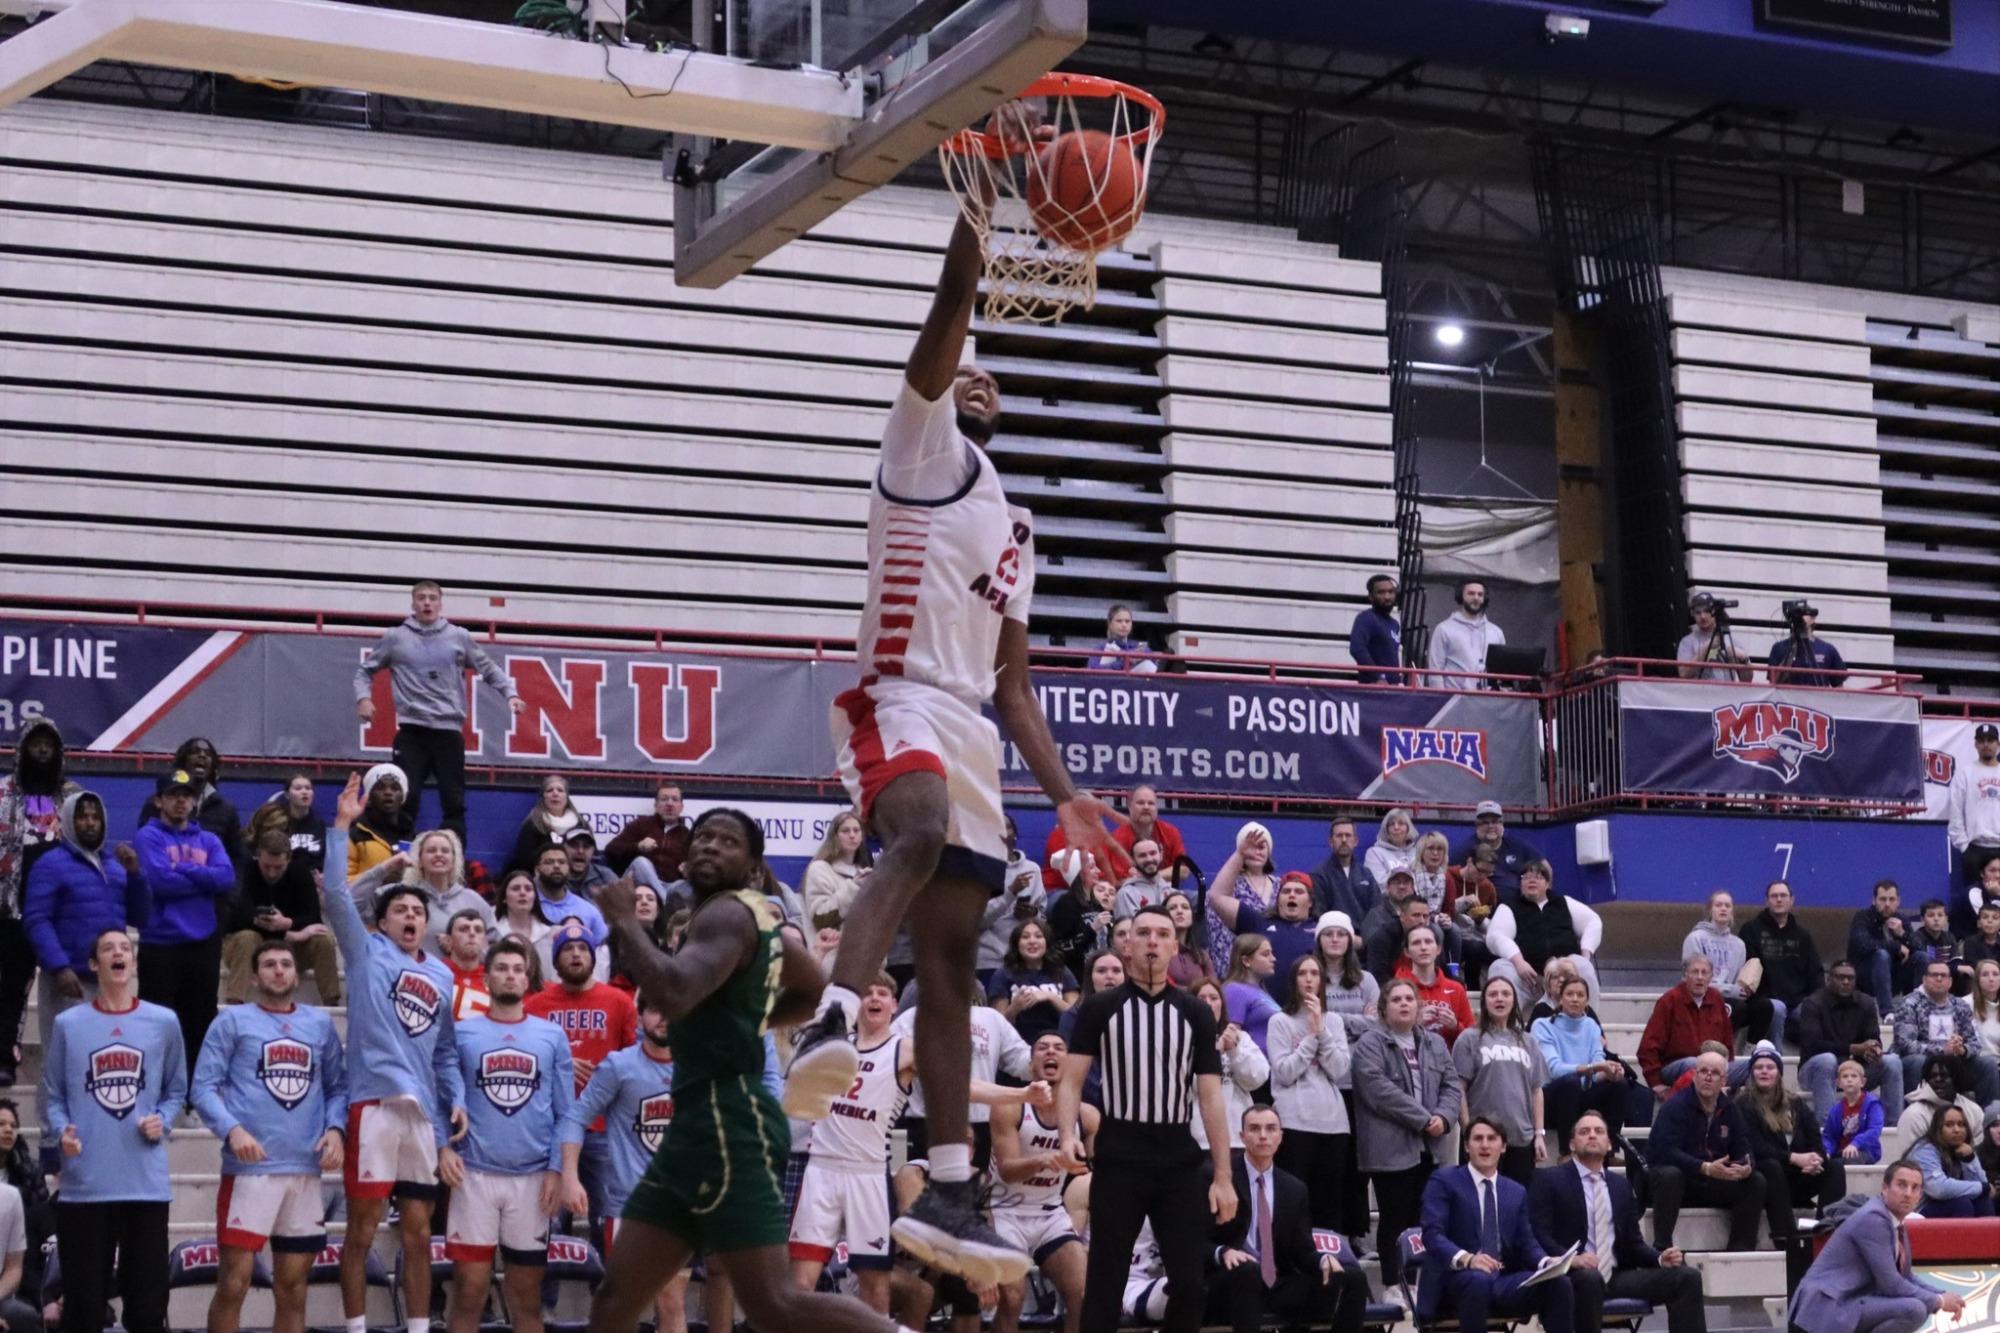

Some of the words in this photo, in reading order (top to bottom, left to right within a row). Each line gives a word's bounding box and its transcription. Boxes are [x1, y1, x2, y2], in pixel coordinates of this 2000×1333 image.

[3, 636, 117, 679] PLINE
[359, 648, 721, 765] NU
[1228, 695, 1360, 736] PASSION
[1714, 702, 1831, 754] MNU
[1382, 727, 1486, 780] NAIA
[755, 818, 804, 841] MNU
[1774, 843, 1794, 880] 7
[547, 1008, 607, 1030] NEER
[485, 1054, 533, 1076] MNU
[1480, 1044, 1531, 1069] MNU
[830, 1101, 877, 1123] MERICA
[547, 1241, 588, 1264] NU
